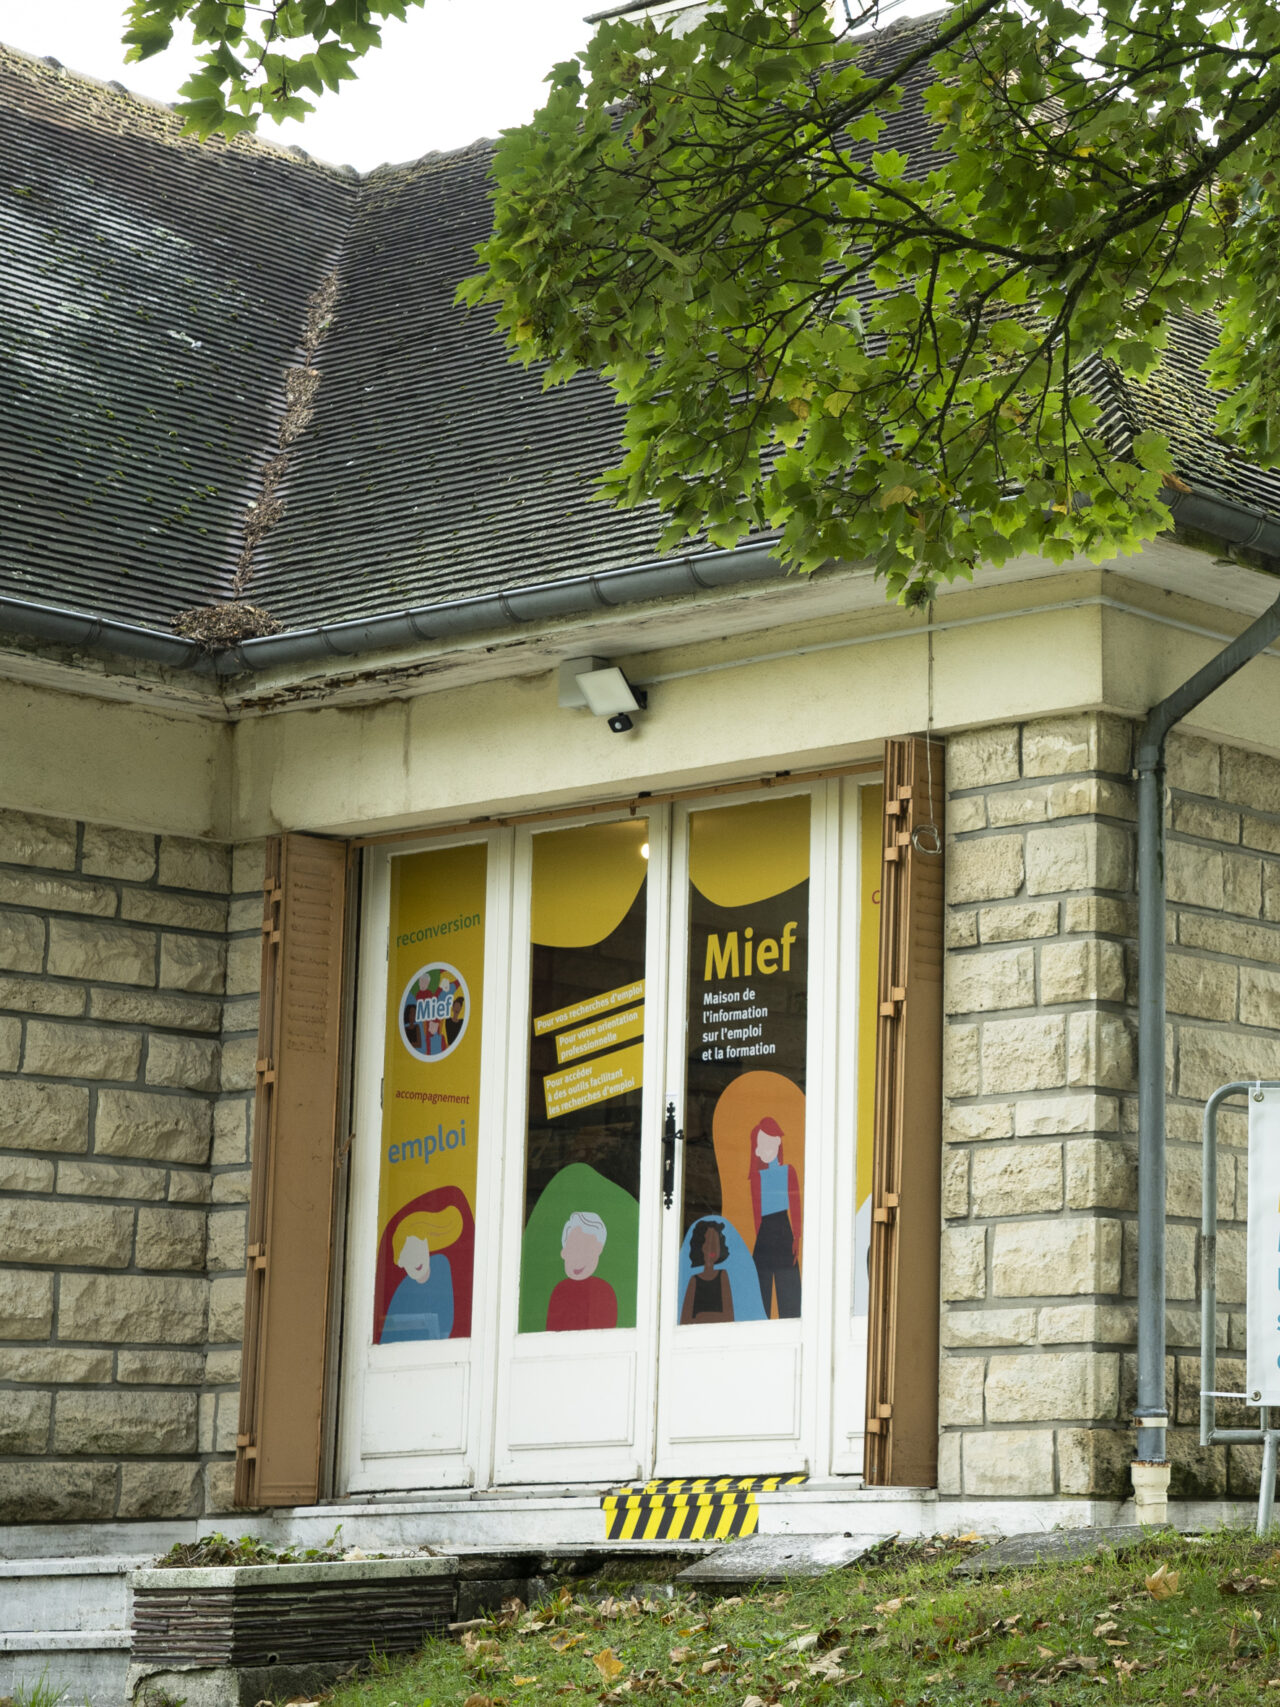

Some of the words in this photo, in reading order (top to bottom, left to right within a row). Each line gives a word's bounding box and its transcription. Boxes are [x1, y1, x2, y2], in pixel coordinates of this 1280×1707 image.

[396, 912, 480, 948] reconversion
[704, 921, 798, 981] Mief
[416, 995, 453, 1020] Mief
[703, 990, 740, 1005] Maison
[743, 987, 756, 1000] de
[537, 1019, 554, 1030] Pour
[555, 1014, 568, 1023] vos
[569, 998, 609, 1018] recherches
[703, 1005, 768, 1024] l'information
[559, 1033, 576, 1047] Pour
[578, 1026, 596, 1040] votre
[598, 1012, 638, 1033] orientation
[702, 1031, 719, 1042] sur
[721, 1024, 762, 1041] l'emploi
[561, 1033, 617, 1061] professionnelle
[702, 1049, 712, 1061] et
[714, 1047, 724, 1059] la
[726, 1042, 776, 1058] formation
[546, 1078, 563, 1089] Pour
[564, 1066, 593, 1083] accéder
[547, 1093, 552, 1103] à
[553, 1089, 567, 1101] des
[568, 1080, 589, 1094] outils
[590, 1068, 623, 1088] facilitant
[395, 1090, 470, 1104] accompagnement
[548, 1104, 560, 1115] les
[561, 1090, 601, 1111] recherches
[388, 1119, 466, 1164] emploi
